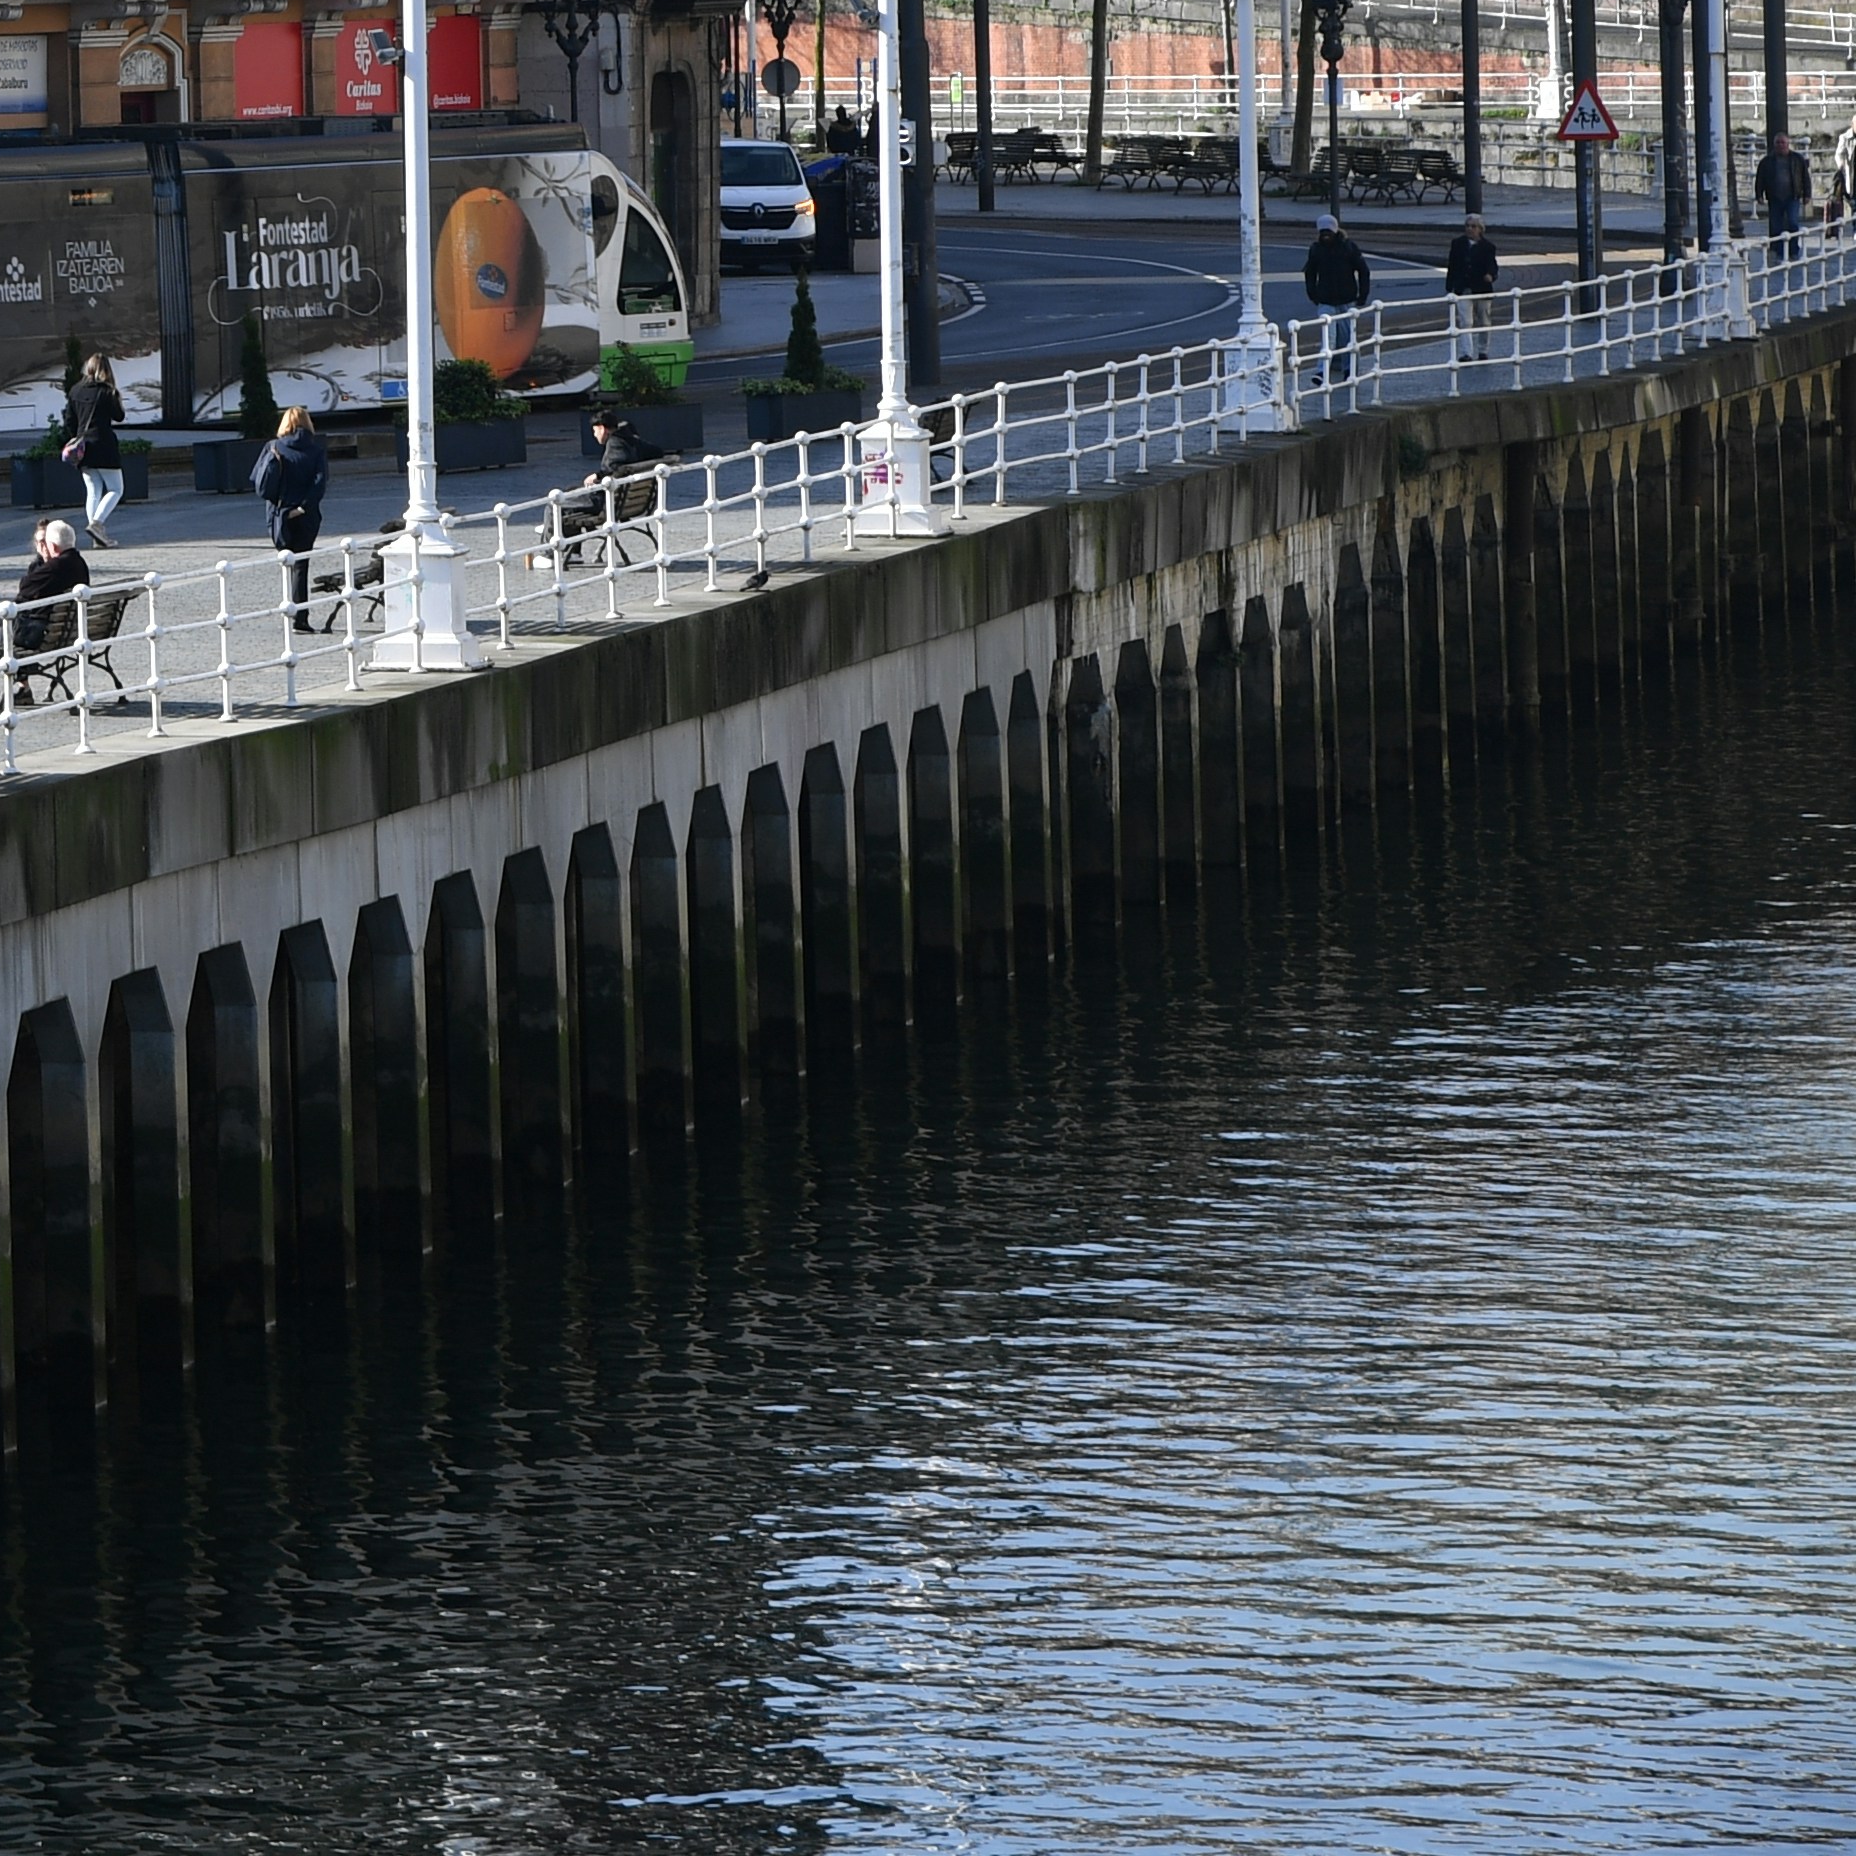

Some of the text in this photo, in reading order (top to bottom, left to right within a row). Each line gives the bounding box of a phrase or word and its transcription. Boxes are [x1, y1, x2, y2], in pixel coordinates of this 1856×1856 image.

[346, 80, 382, 98] Caritas
[258, 211, 328, 247] Fontestad
[65, 239, 114, 259] FAMILIA
[56, 256, 125, 278] IZATEAREN
[223, 229, 362, 300] Laranja
[69, 275, 115, 295] BALIOA
